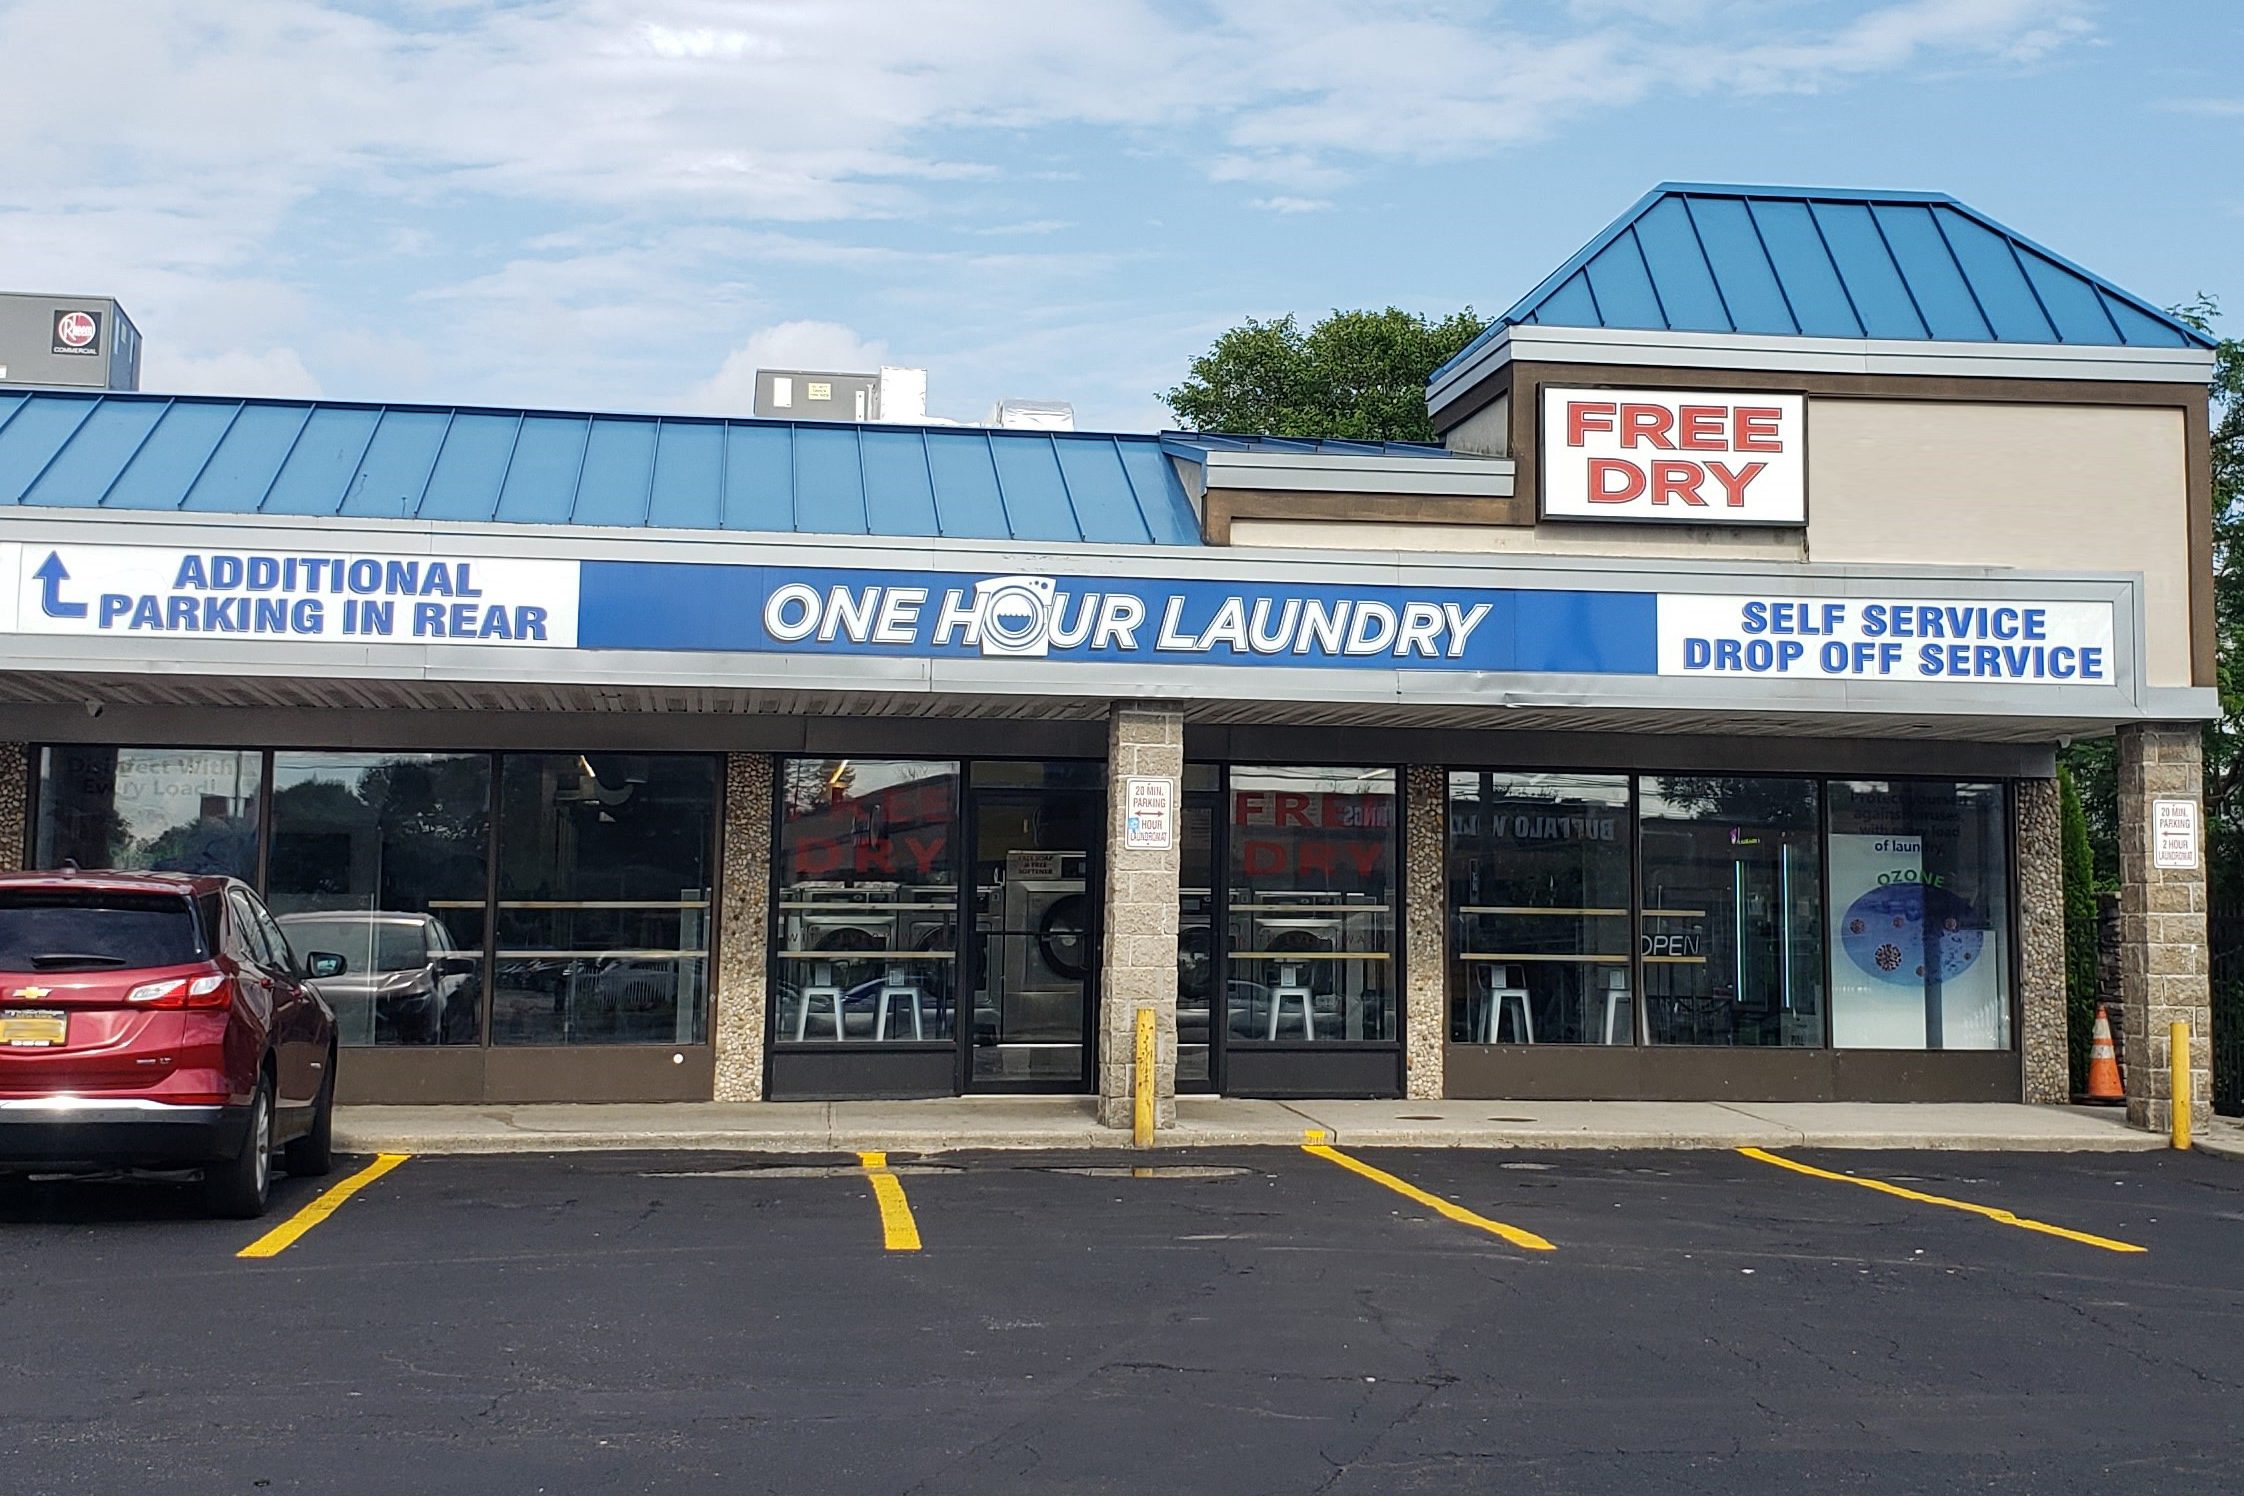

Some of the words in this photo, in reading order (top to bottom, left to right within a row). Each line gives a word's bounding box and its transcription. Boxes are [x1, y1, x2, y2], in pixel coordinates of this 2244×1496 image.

[1567, 401, 1783, 453] FREE
[1587, 457, 1768, 508] DRY
[173, 554, 482, 598] ADDITIONAL
[99, 593, 324, 634] PARKING
[343, 600, 394, 636] IN
[413, 602, 548, 640] REAR
[764, 582, 928, 644] ONE
[1155, 595, 1494, 657] LAUNDRY
[1741, 601, 1845, 637] SELF
[1861, 604, 2047, 641] SERVICE
[1683, 638, 1805, 673] DROP
[1819, 640, 1903, 675] OFF
[1917, 643, 2103, 679] SERVICE
[1133, 798, 1165, 807] PARKING
[1136, 786, 1144, 795] 20
[1147, 786, 1164, 796] MIN.
[1142, 820, 1162, 829] HOUR
[2159, 819, 2190, 828] PARKING
[2161, 808, 2170, 816] 20
[2172, 808, 2188, 817] MIN.
[796, 837, 946, 873] DRY
[1243, 840, 1384, 876] DRY
[1874, 840, 1889, 852] of
[2163, 840, 2167, 849] 2
[2169, 840, 2188, 850] HOUR
[1877, 869, 1945, 888] OZONE
[1642, 935, 1699, 956] OPEN
